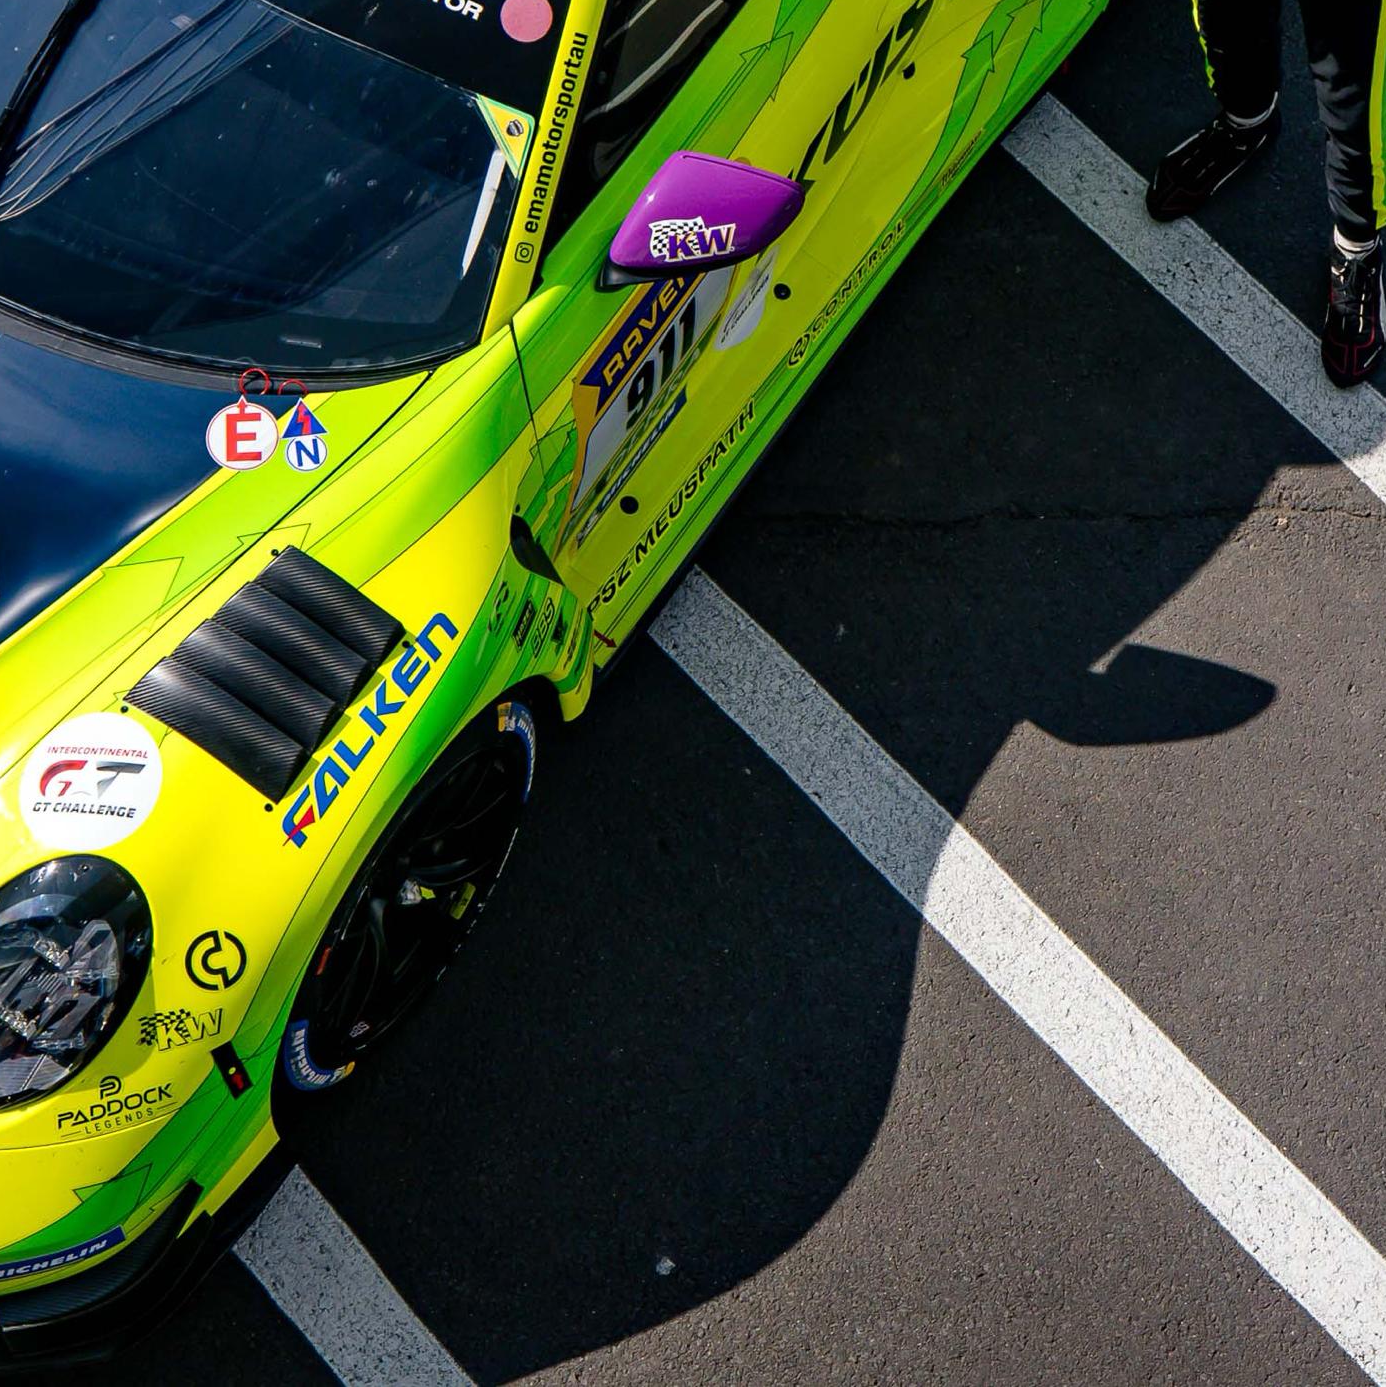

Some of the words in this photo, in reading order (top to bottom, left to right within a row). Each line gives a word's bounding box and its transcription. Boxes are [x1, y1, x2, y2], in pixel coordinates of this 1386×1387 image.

[523, 30, 590, 236] emamotorsportau
[666, 221, 737, 262] KW
[624, 295, 697, 432] 911
[225, 412, 262, 462] E
[294, 437, 321, 467] N
[633, 400, 756, 565] MEUSPATH
[46, 745, 150, 760] INTERCONTINENTAL
[282, 611, 459, 850] FALKEN
[31, 801, 52, 814] GT
[50, 801, 138, 819] CHALLENGE
[157, 1008, 223, 1053] KW
[57, 1082, 173, 1130] PADDOCK
[84, 1105, 156, 1135] LEGENDS
